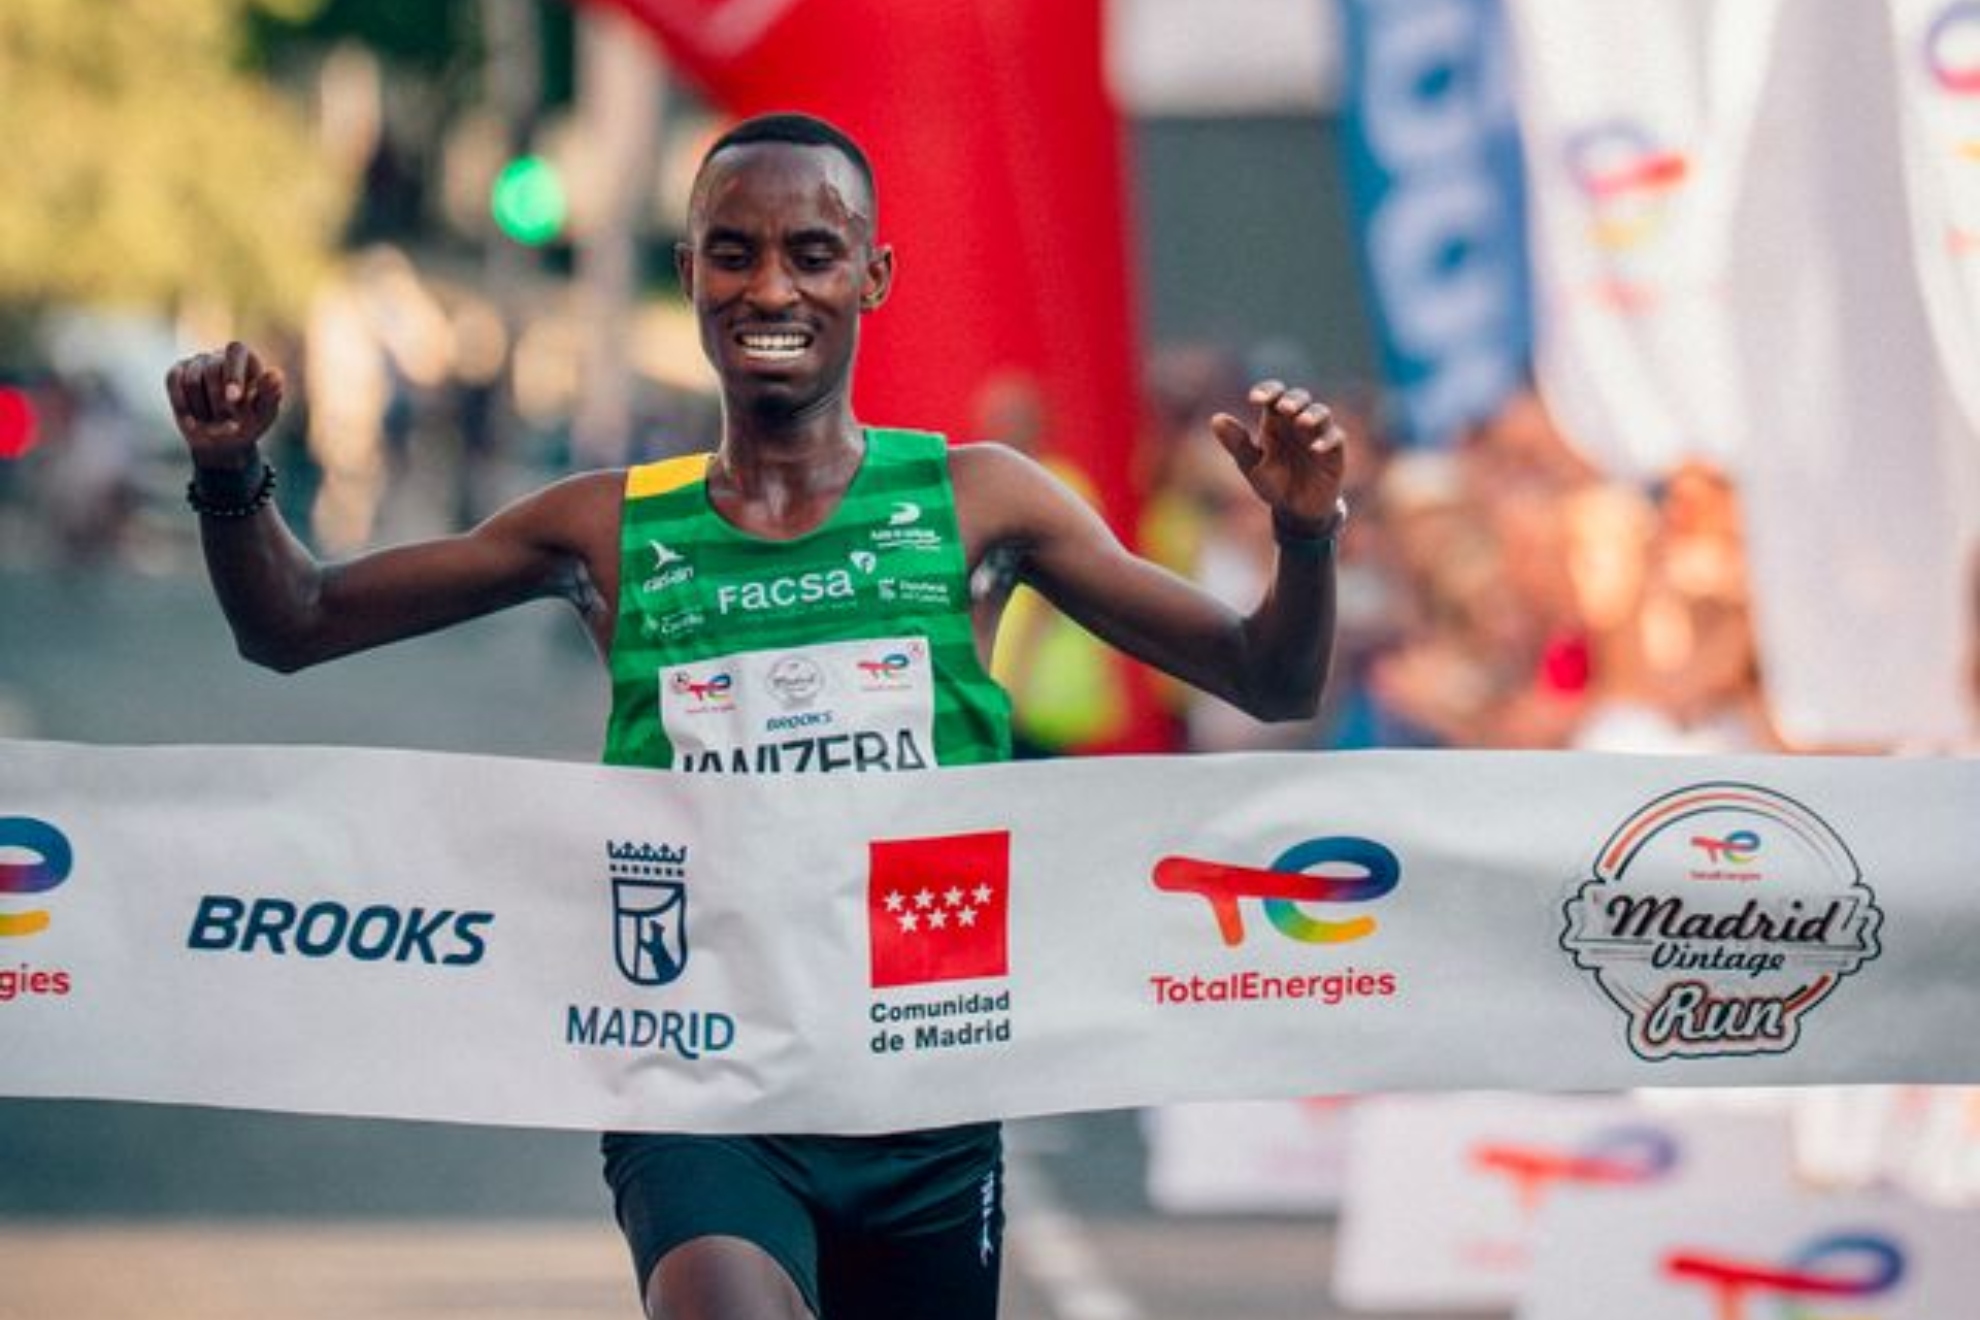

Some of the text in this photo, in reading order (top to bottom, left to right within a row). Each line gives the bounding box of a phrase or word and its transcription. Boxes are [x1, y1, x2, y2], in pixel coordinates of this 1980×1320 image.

[767, 710, 832, 731] BROOKS
[186, 894, 496, 967] BROOKS
[1606, 895, 1840, 944] Madrid
[1651, 942, 1786, 978] Vintage
[870, 989, 1010, 1022] Comunidad
[1150, 968, 1397, 1006] TotalEnergies
[1648, 981, 1784, 1044] Run
[566, 1004, 735, 1060] MADRID
[870, 1018, 1010, 1053] de Madrid
